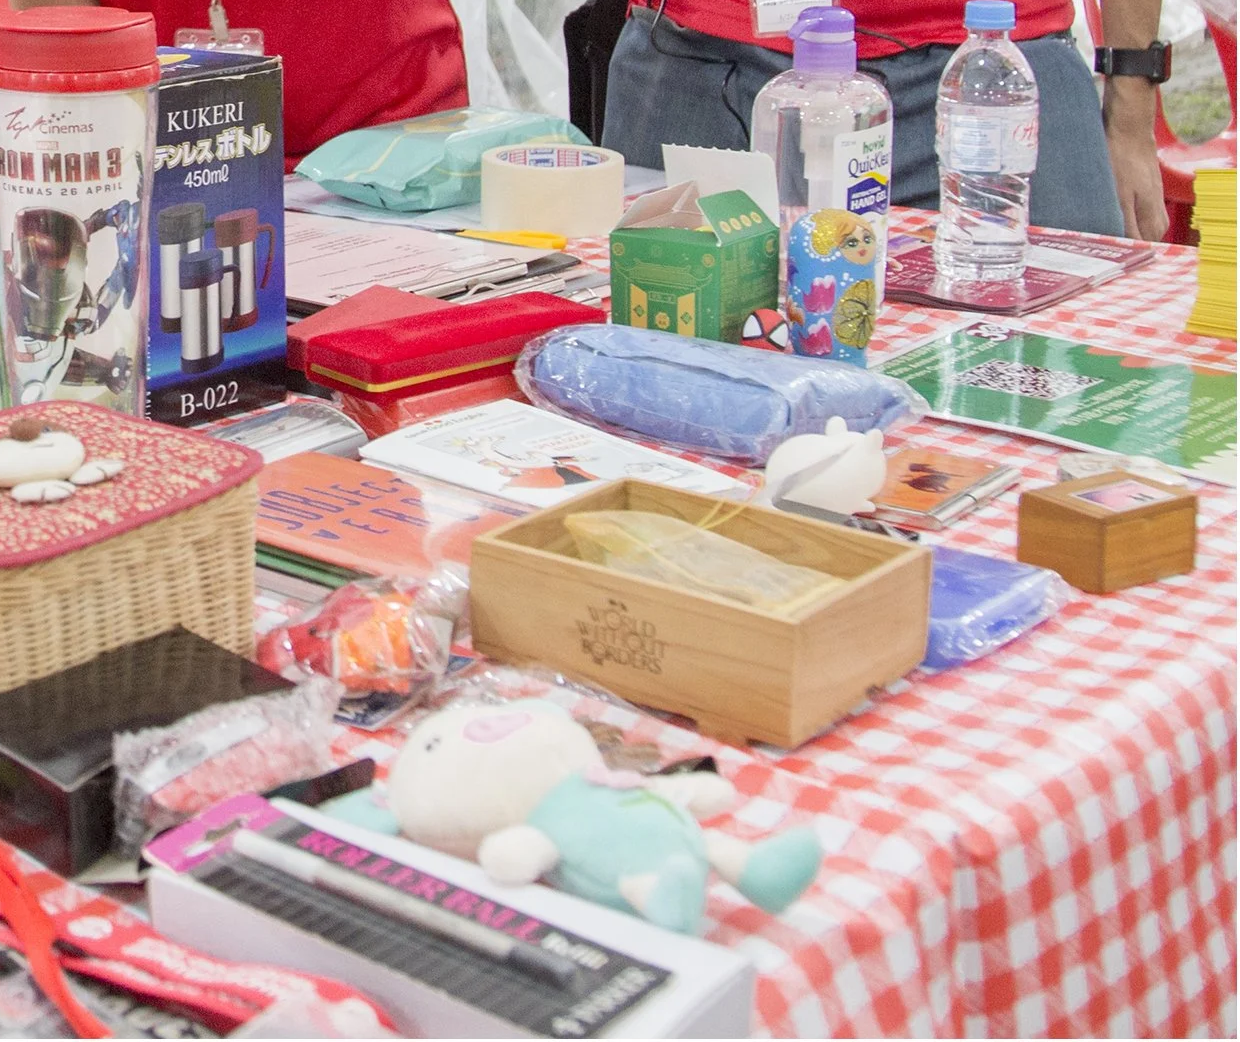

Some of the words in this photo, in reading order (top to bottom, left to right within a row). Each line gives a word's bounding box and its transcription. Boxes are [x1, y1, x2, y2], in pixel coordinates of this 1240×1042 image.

[40, 123, 94, 134] Cinemas
[166, 101, 244, 133] KUKERI
[215, 122, 273, 161] ボトル
[42, 151, 102, 183] MAN
[106, 147, 122, 179] 3
[3, 182, 53, 196] CINEMAS
[60, 187, 78, 196] 26
[85, 181, 123, 195] APRIL
[850, 194, 875, 211] HAND
[180, 381, 239, 418] B-022
[574, 618, 666, 660] WITHOUT
[586, 604, 657, 639] WORLD
[580, 636, 663, 675] BORDERS
[441, 886, 546, 946] BALL
